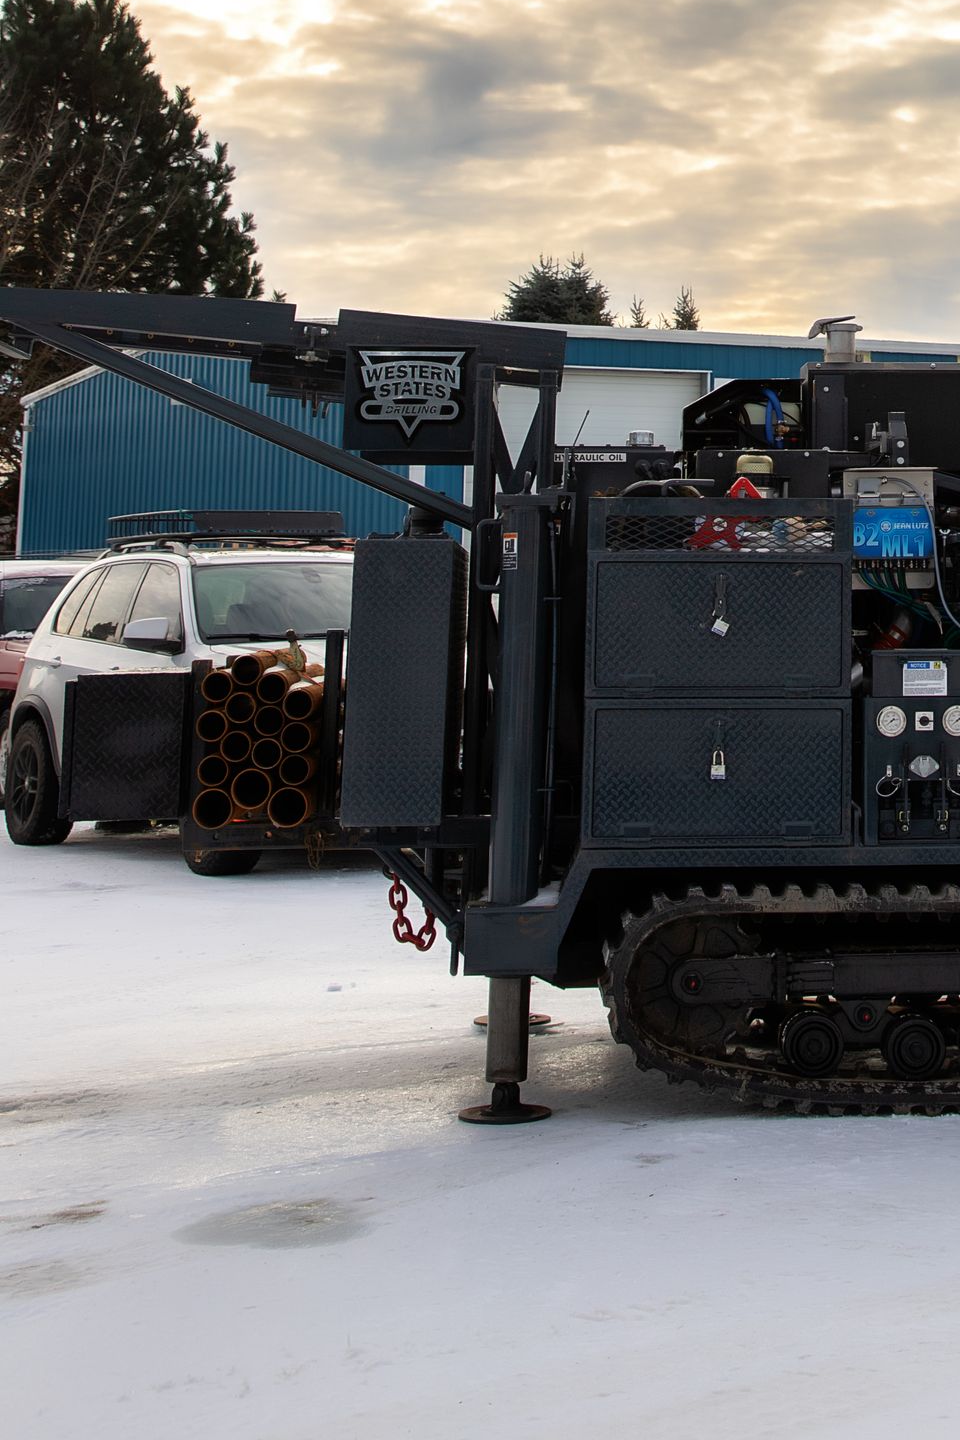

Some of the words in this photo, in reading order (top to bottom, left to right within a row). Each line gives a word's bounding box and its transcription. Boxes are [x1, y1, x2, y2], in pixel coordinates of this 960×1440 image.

[366, 365, 456, 383] WESTERN
[379, 381, 446, 399] STATES
[385, 405, 438, 415] DRILLING
[554, 453, 605, 462] HRAULIC
[608, 453, 624, 462] OIL
[853, 523, 879, 546] B2
[893, 522, 911, 530] JEAN
[912, 522, 929, 530] LUTZ
[881, 534, 925, 558] ML1
